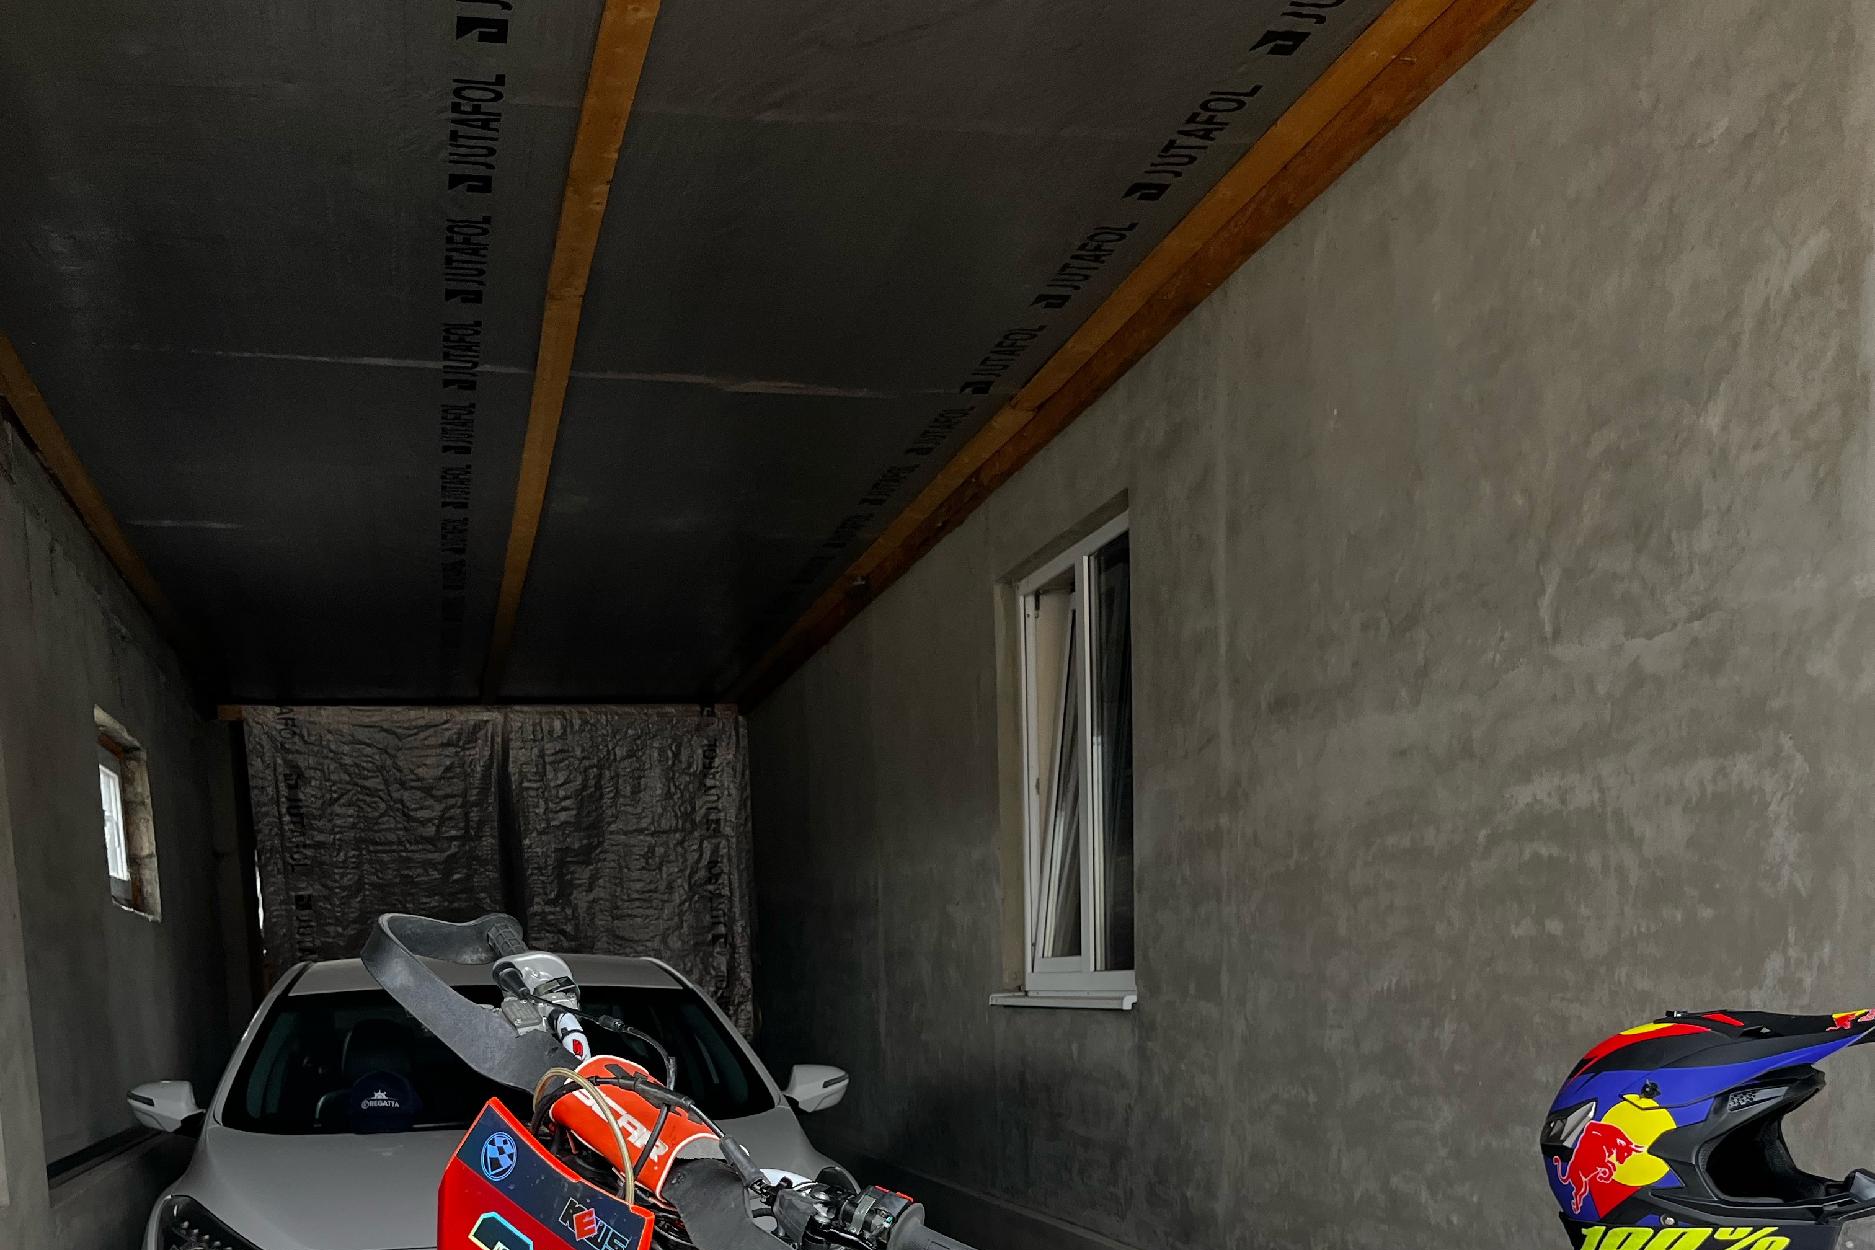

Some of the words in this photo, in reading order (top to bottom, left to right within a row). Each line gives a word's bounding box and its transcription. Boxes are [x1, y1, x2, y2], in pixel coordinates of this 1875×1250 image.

[451, 74, 506, 169] JUTAFOL
[1144, 84, 1263, 178] JUTAFOL
[445, 216, 491, 286] JUTAFOL
[1046, 222, 1139, 291] JUTAFOL
[441, 321, 482, 376] JUTAFOL
[971, 325, 1047, 377] JUTAFOL
